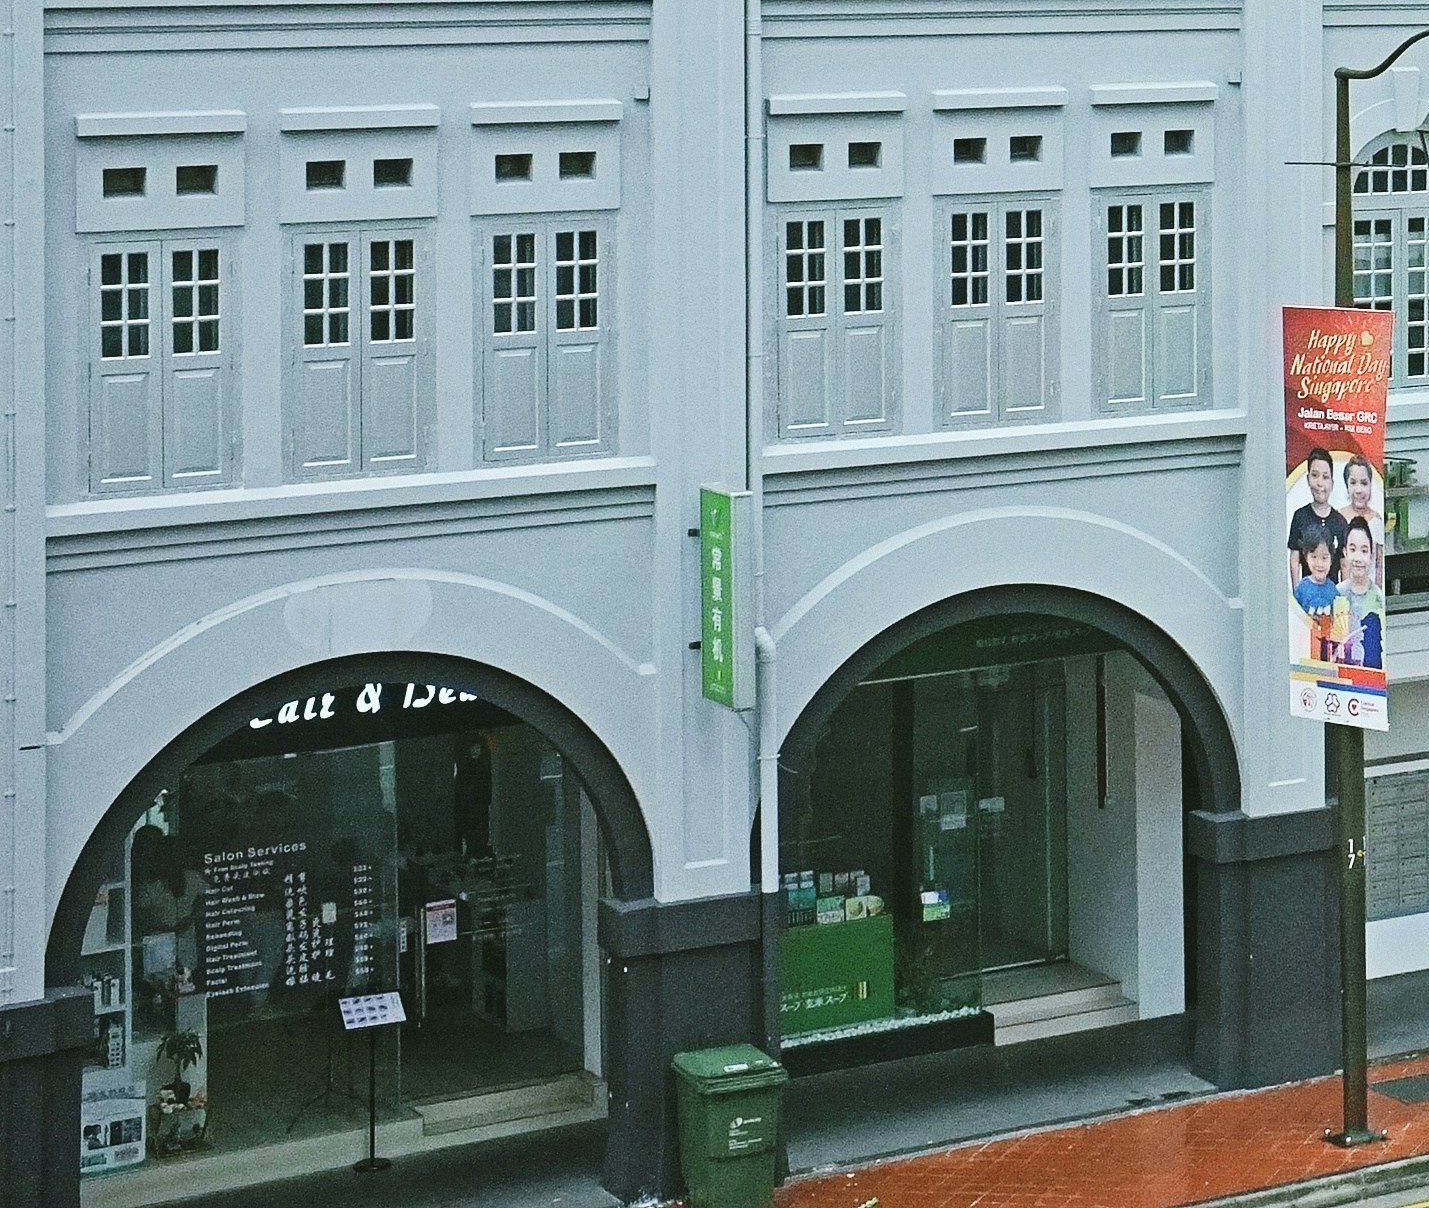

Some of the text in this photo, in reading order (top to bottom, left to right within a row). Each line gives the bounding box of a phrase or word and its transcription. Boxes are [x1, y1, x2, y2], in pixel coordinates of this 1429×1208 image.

[1308, 329, 1358, 356] Happy
[1290, 353, 1388, 381] National Day
[1297, 375, 1375, 403] Singapore
[1298, 407, 1378, 424] Jalan Besar GRC
[204, 842, 307, 865] Salon Services
